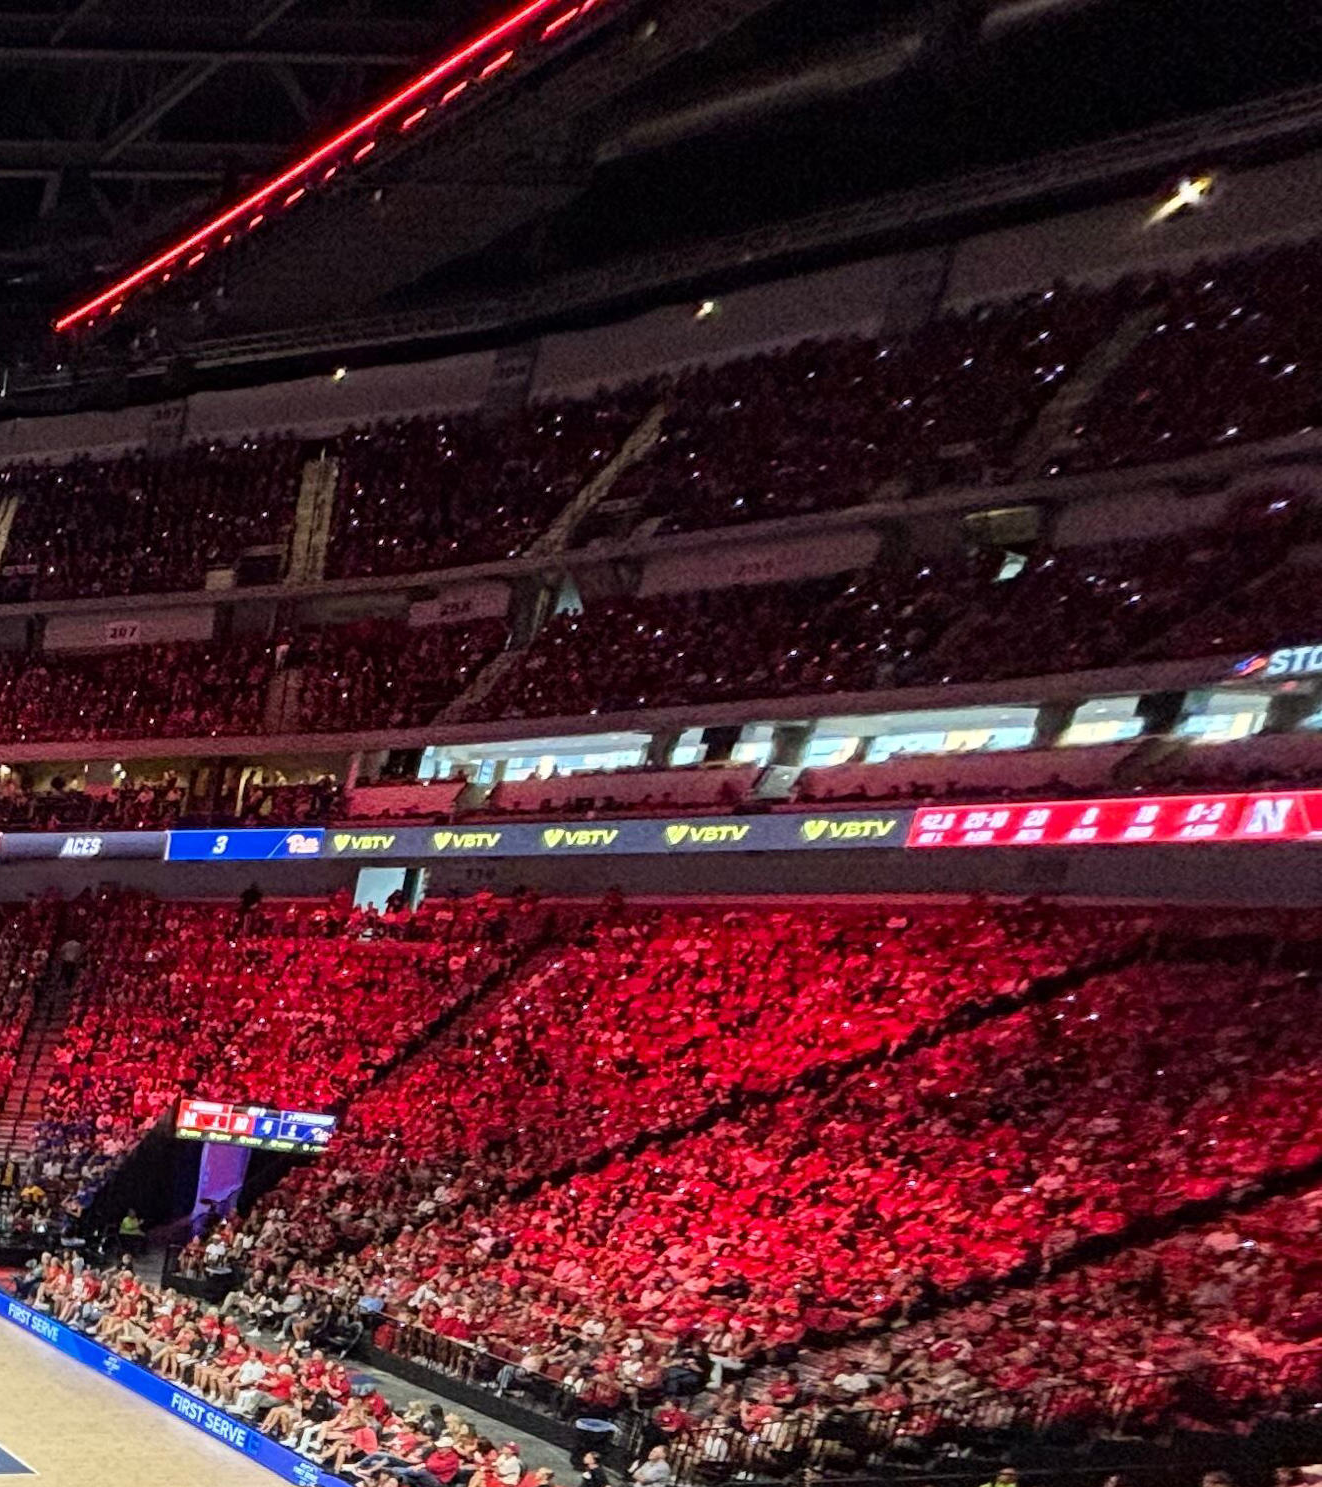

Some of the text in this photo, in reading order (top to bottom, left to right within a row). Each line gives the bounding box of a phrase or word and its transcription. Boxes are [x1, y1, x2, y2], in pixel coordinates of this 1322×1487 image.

[109, 625, 138, 639] 207
[1246, 799, 1294, 833] N
[565, 828, 619, 846] VBTV
[682, 824, 750, 844] VBTV
[828, 819, 897, 840] VBTV
[61, 836, 103, 856] ACES
[212, 834, 228, 855] 3
[351, 834, 395, 850] VBTV
[451, 831, 501, 849] VBTV
[8, 1302, 59, 1343] FIRST SERVE
[171, 1393, 247, 1449] FIRST SERVE
